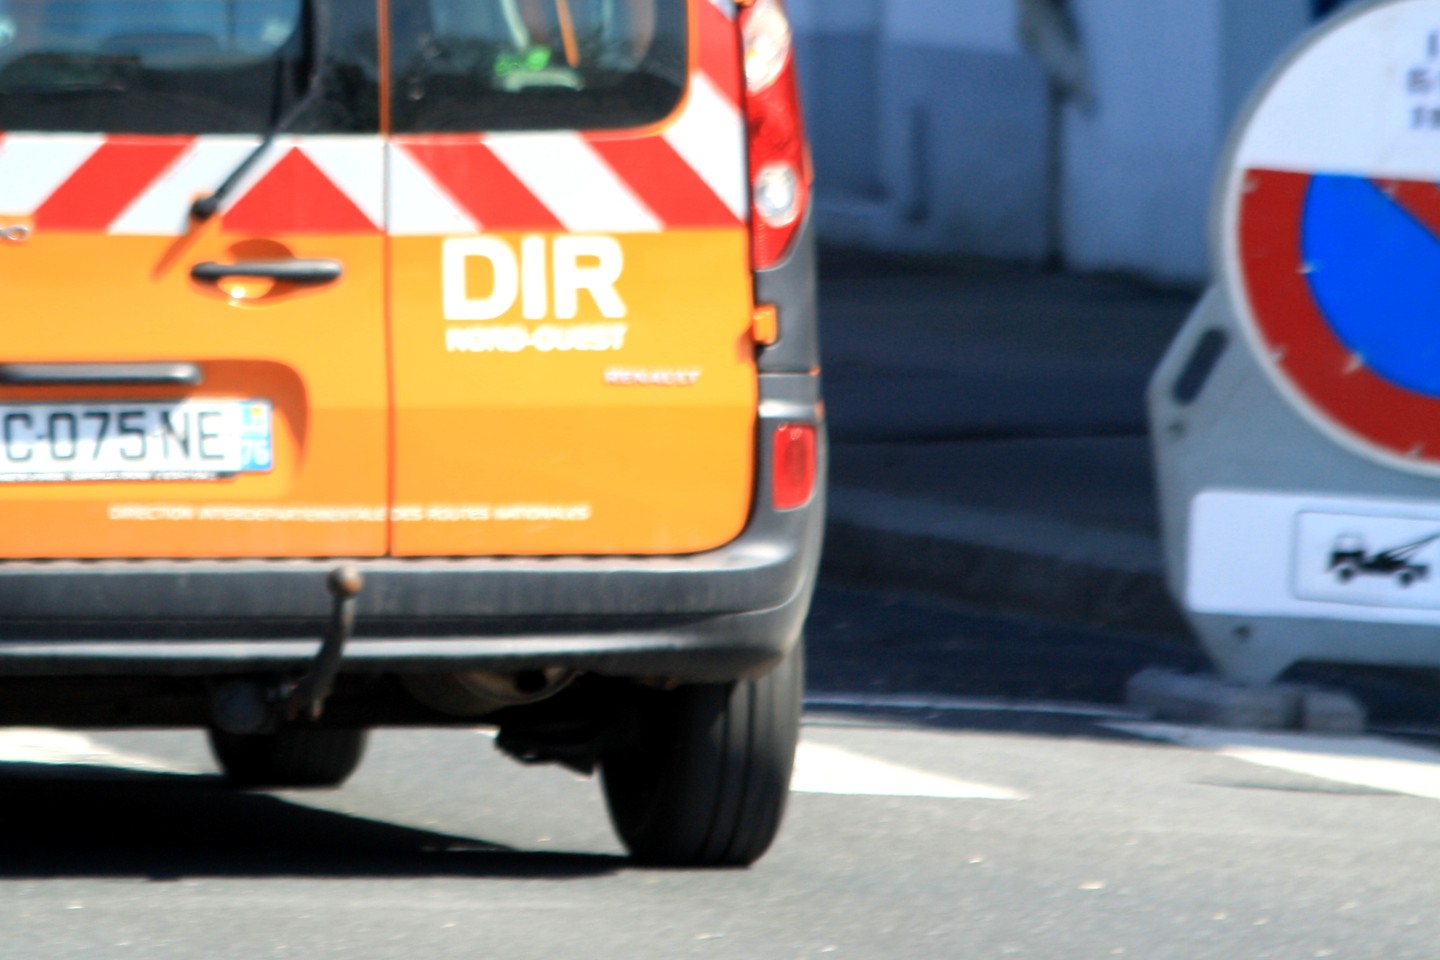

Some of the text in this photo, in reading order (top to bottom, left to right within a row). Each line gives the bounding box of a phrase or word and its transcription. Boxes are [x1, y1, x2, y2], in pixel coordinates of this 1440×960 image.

[442, 235, 627, 320] DIR
[444, 324, 628, 352] NORD-OUEST
[603, 366, 702, 385] RENAULT
